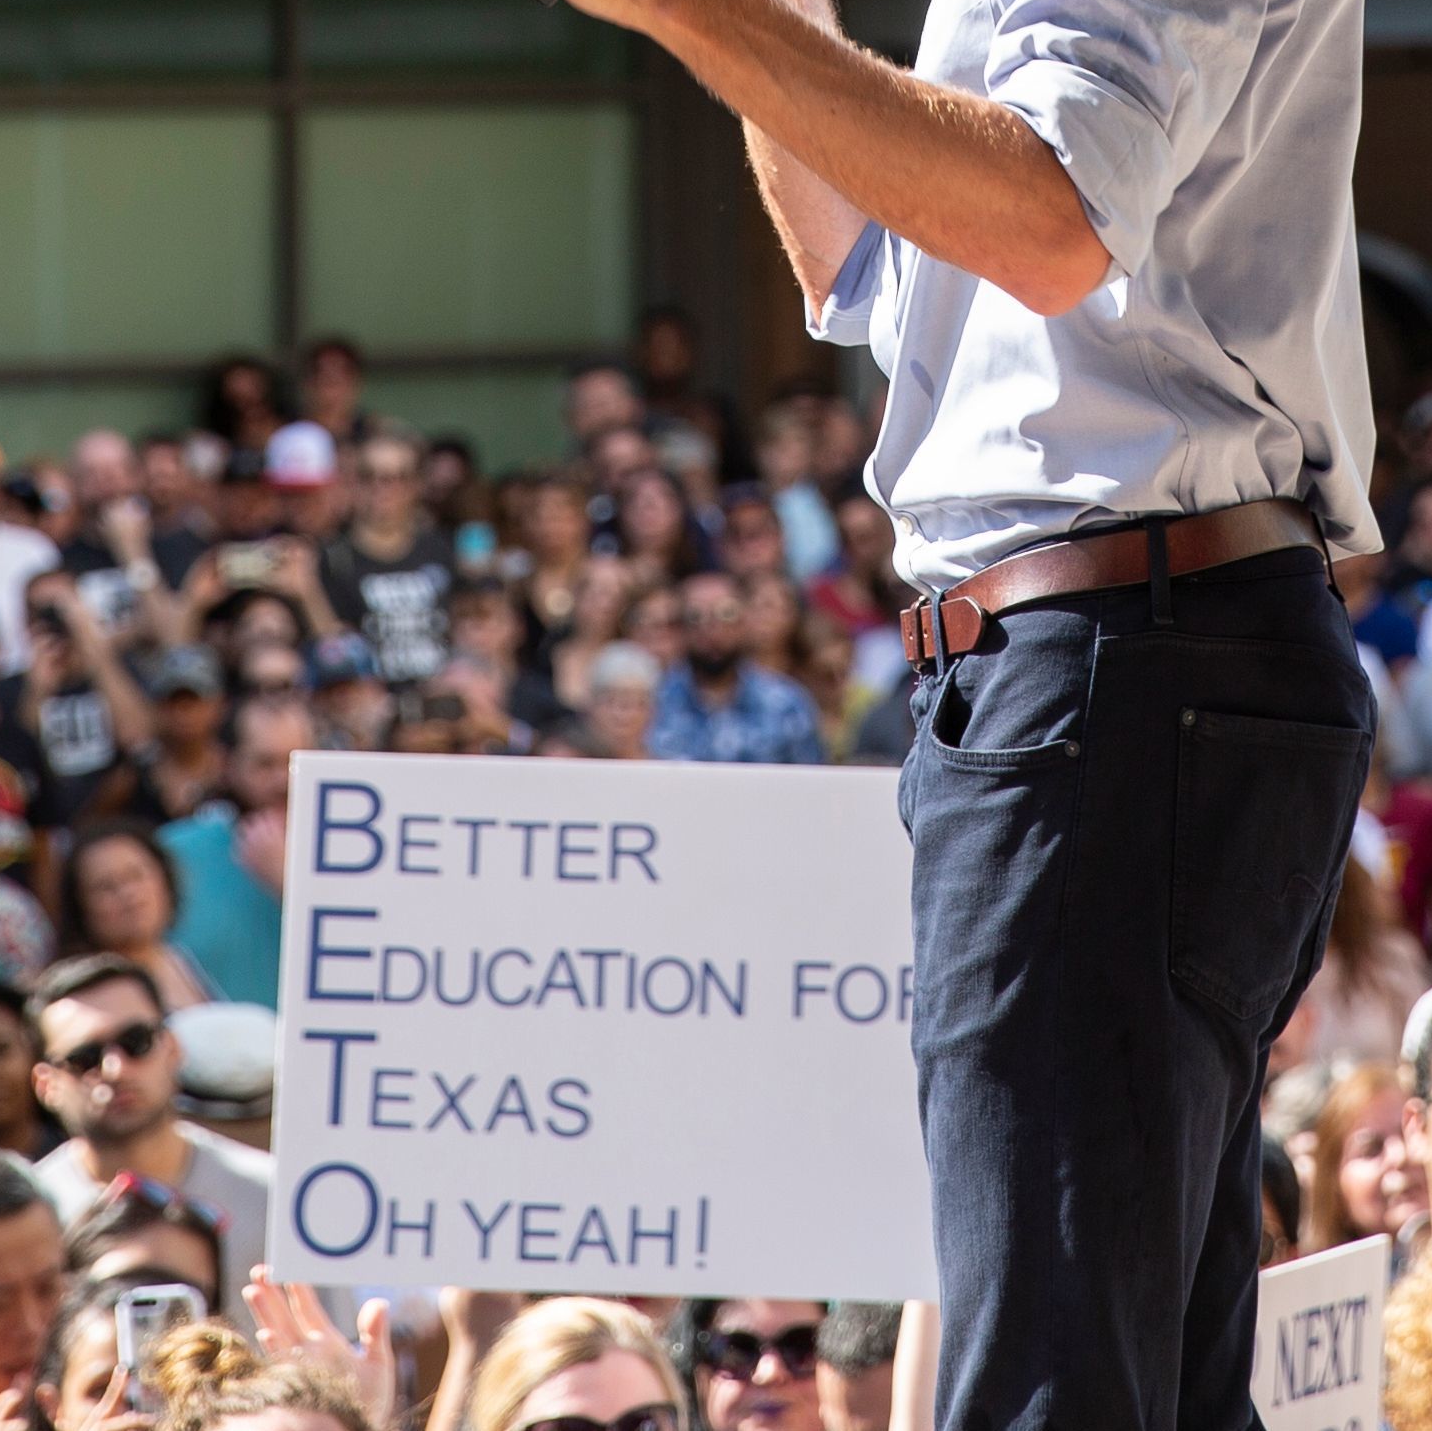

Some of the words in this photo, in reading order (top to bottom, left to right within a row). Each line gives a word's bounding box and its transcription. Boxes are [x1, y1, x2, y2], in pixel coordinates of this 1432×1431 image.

[312, 780, 662, 883] BETTER
[305, 906, 749, 1020] EDUCATION
[301, 1030, 593, 1139] TEXAS
[292, 1161, 437, 1260] OH
[461, 1195, 712, 1269] YEAH!
[1271, 1294, 1367, 1409] NEXT
